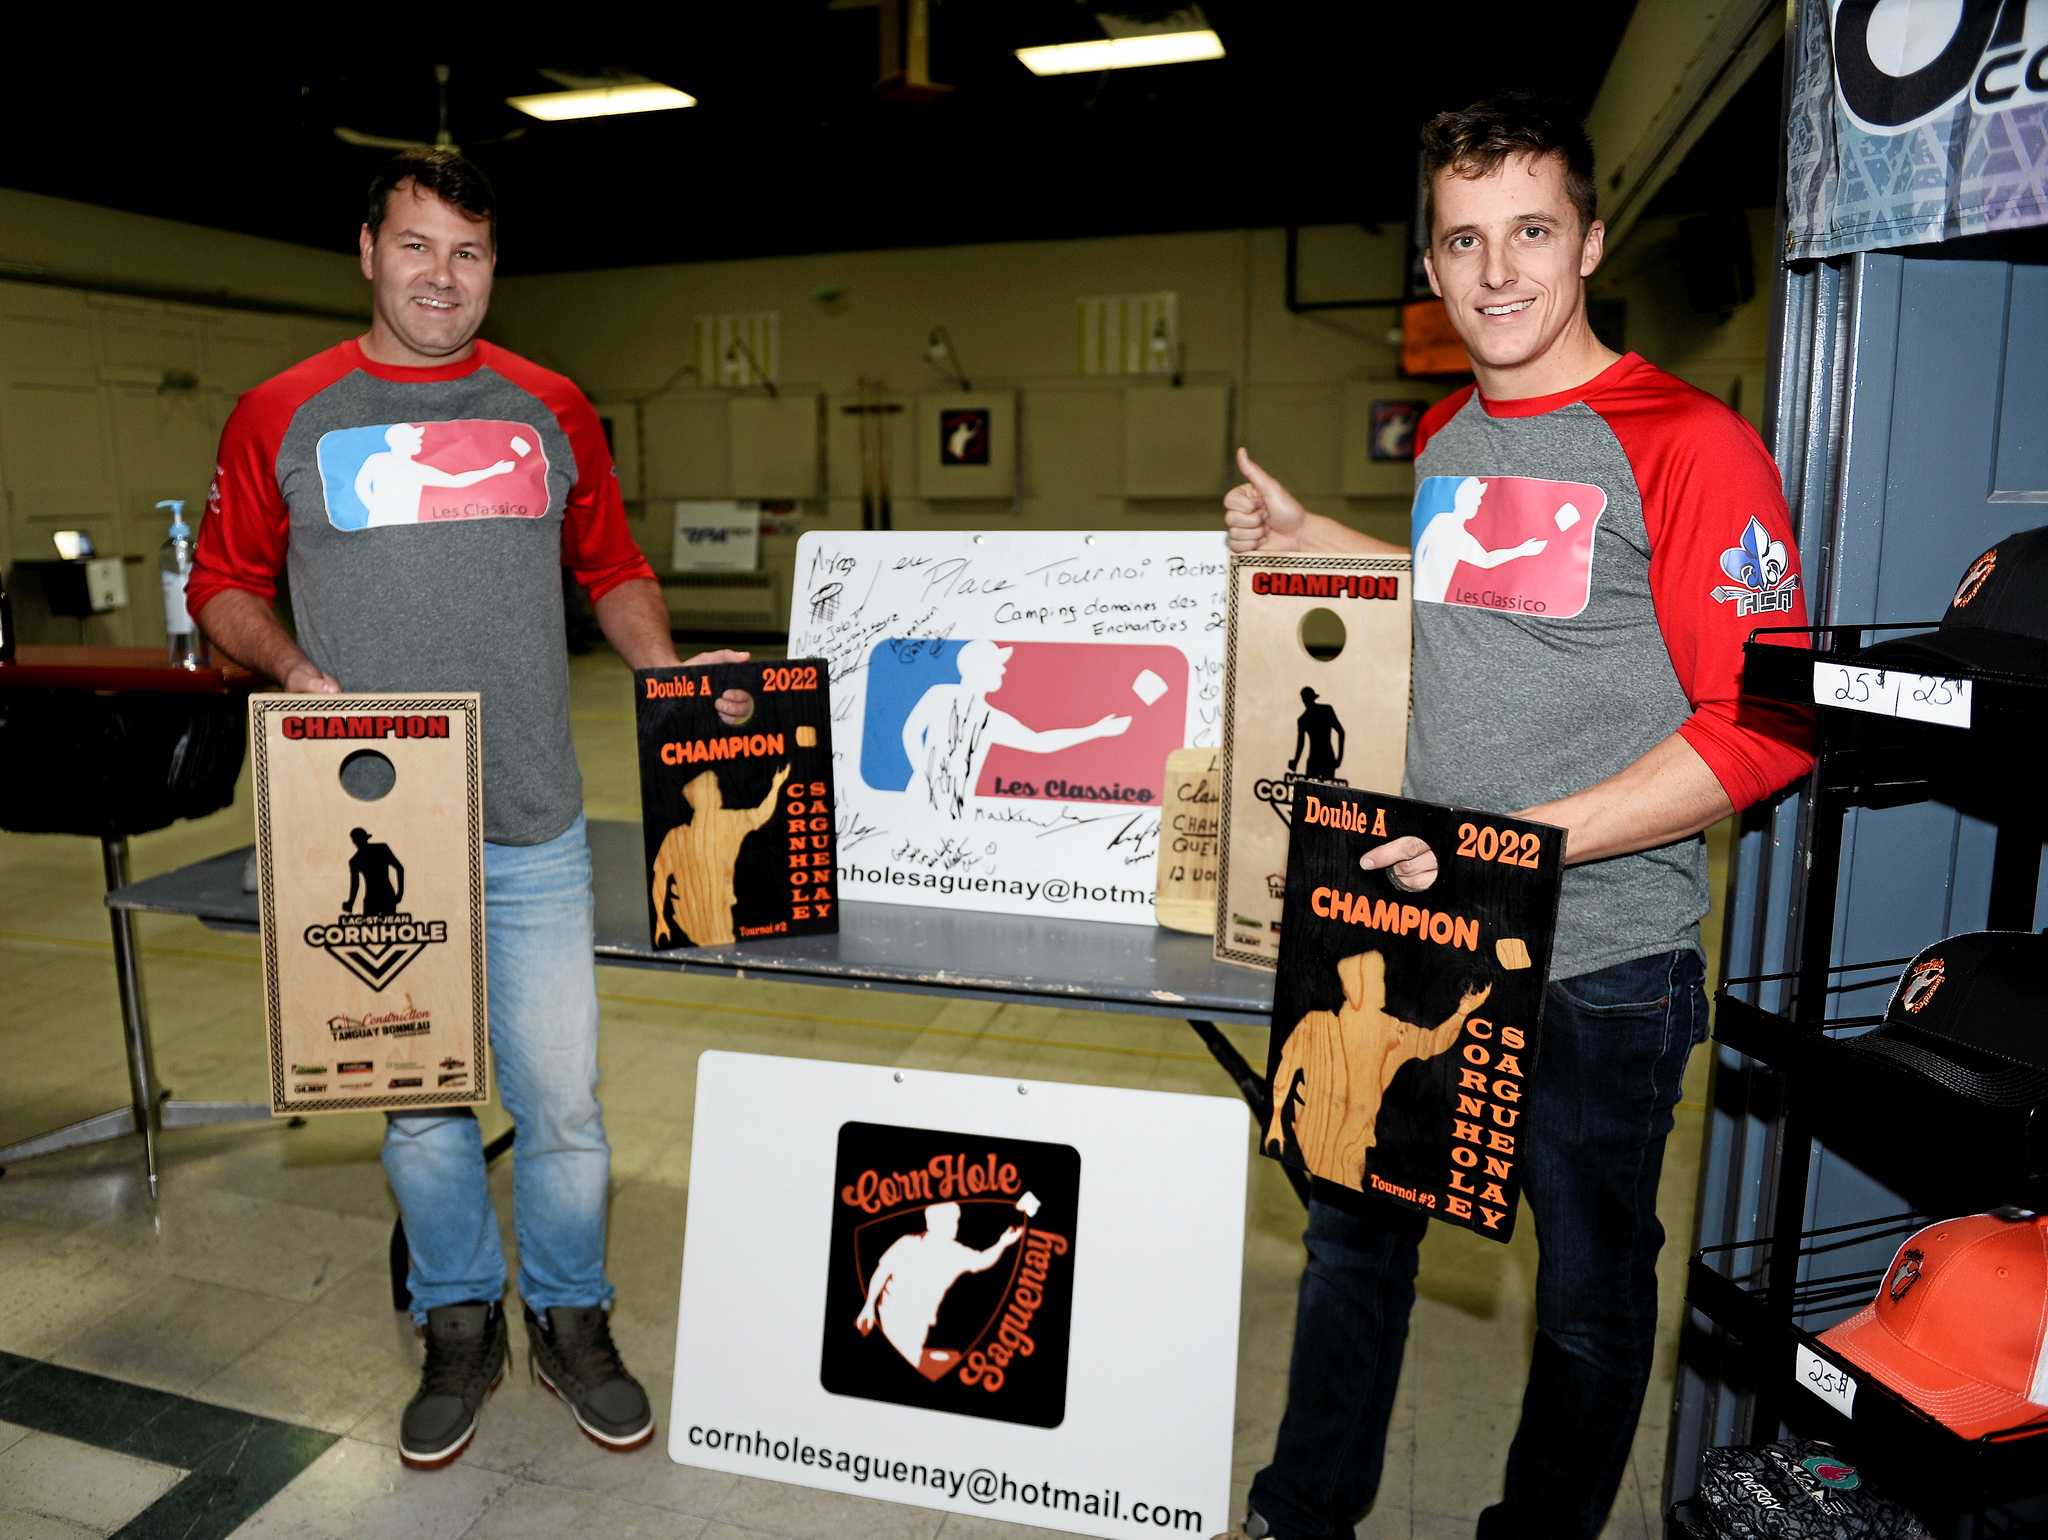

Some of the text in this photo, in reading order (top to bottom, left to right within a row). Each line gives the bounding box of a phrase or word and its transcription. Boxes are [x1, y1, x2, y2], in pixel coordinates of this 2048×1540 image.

[432, 502, 527, 518] Les Classico
[921, 557, 1016, 602] Place
[1026, 556, 1151, 588] Tournoi
[1252, 571, 1398, 600] CHAMPION
[995, 602, 1077, 624] Camping
[1169, 593, 1198, 609] des
[1456, 587, 1547, 613] Les Classico
[646, 675, 712, 699] Double A
[762, 667, 818, 691] 2022
[282, 715, 450, 740] CHAMPION
[661, 733, 785, 766] CHAMPION
[995, 776, 1155, 803] Les Classico
[1304, 795, 1389, 838] Double A
[786, 783, 811, 920] CORNHOLE
[809, 781, 833, 918] SAGUENAY
[1456, 822, 1541, 869] 2022
[305, 922, 447, 946] CORNHOLE
[341, 914, 410, 925] LAC-ST-JEAN
[739, 921, 787, 937] Tournoi #2
[1311, 886, 1480, 952] CHAMPION
[331, 1026, 379, 1042] TANGUAY
[382, 1020, 431, 1036] BONNEAU
[361, 1008, 431, 1028] Construction
[1445, 1017, 1493, 1220] CORNHOLE
[1479, 1026, 1525, 1231] SAGUENAY
[841, 1152, 1022, 1214] CornHole
[1370, 1173, 1436, 1209] Tournoi #2
[959, 1227, 1069, 1393] Saguenay
[1808, 1359, 1849, 1399] 25$
[687, 1421, 1203, 1534] cornholesaguenay@hotmail.com
[1733, 1471, 1787, 1511] ENERGY
